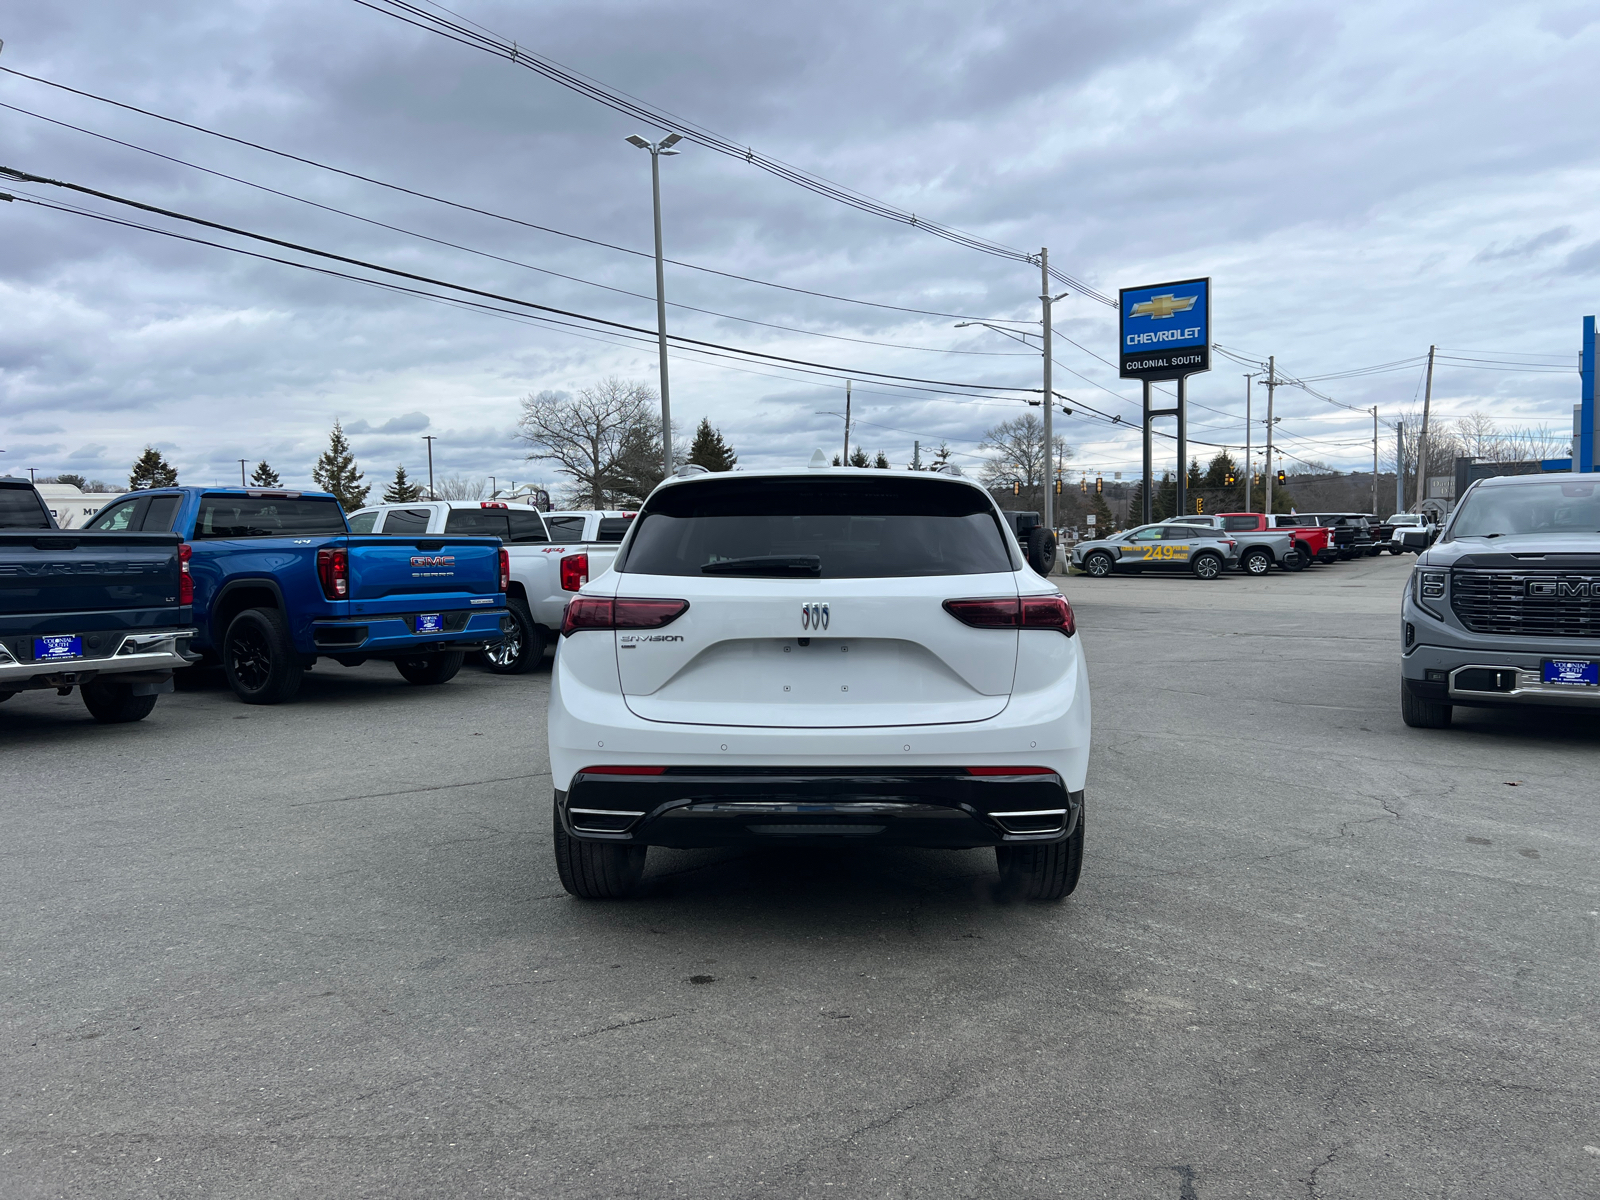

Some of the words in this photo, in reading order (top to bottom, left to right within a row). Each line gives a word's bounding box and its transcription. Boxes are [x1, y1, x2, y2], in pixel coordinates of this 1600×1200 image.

[1126, 327, 1201, 346] CHEVROLET
[1126, 358, 1169, 370] COLONIAL
[1171, 355, 1202, 366] SOUTH
[410, 556, 455, 567] GMC
